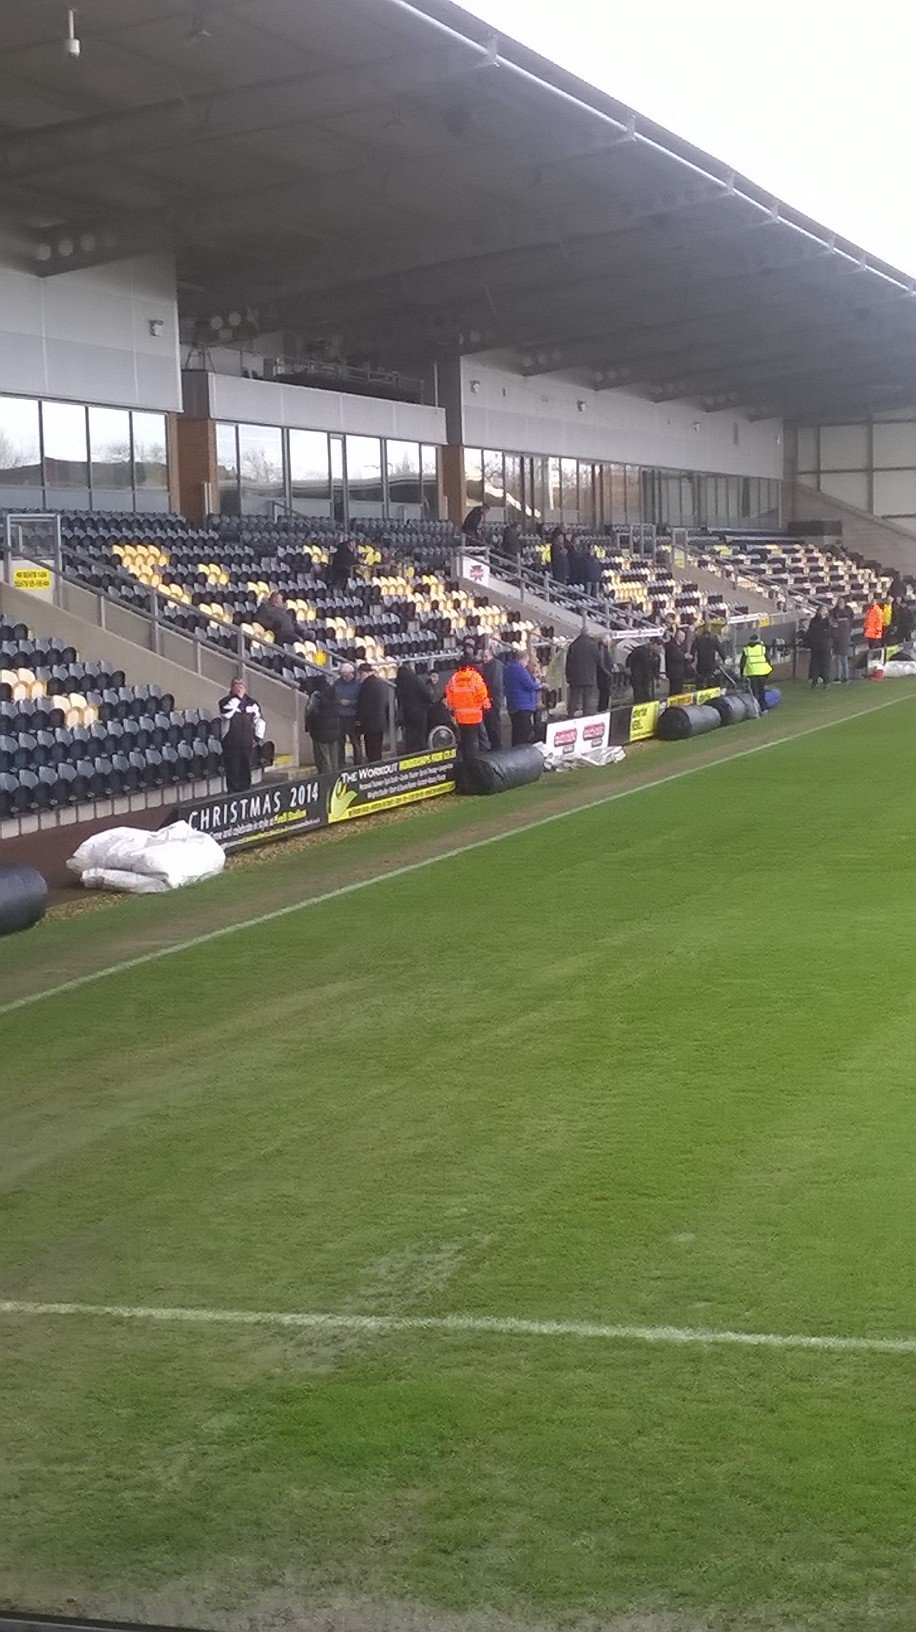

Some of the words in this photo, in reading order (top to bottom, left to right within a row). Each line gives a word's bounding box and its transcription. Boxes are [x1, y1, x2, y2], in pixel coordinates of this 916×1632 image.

[341, 772, 358, 784] THE
[189, 791, 281, 831] CHRISTMAS
[290, 782, 319, 808] 2014
